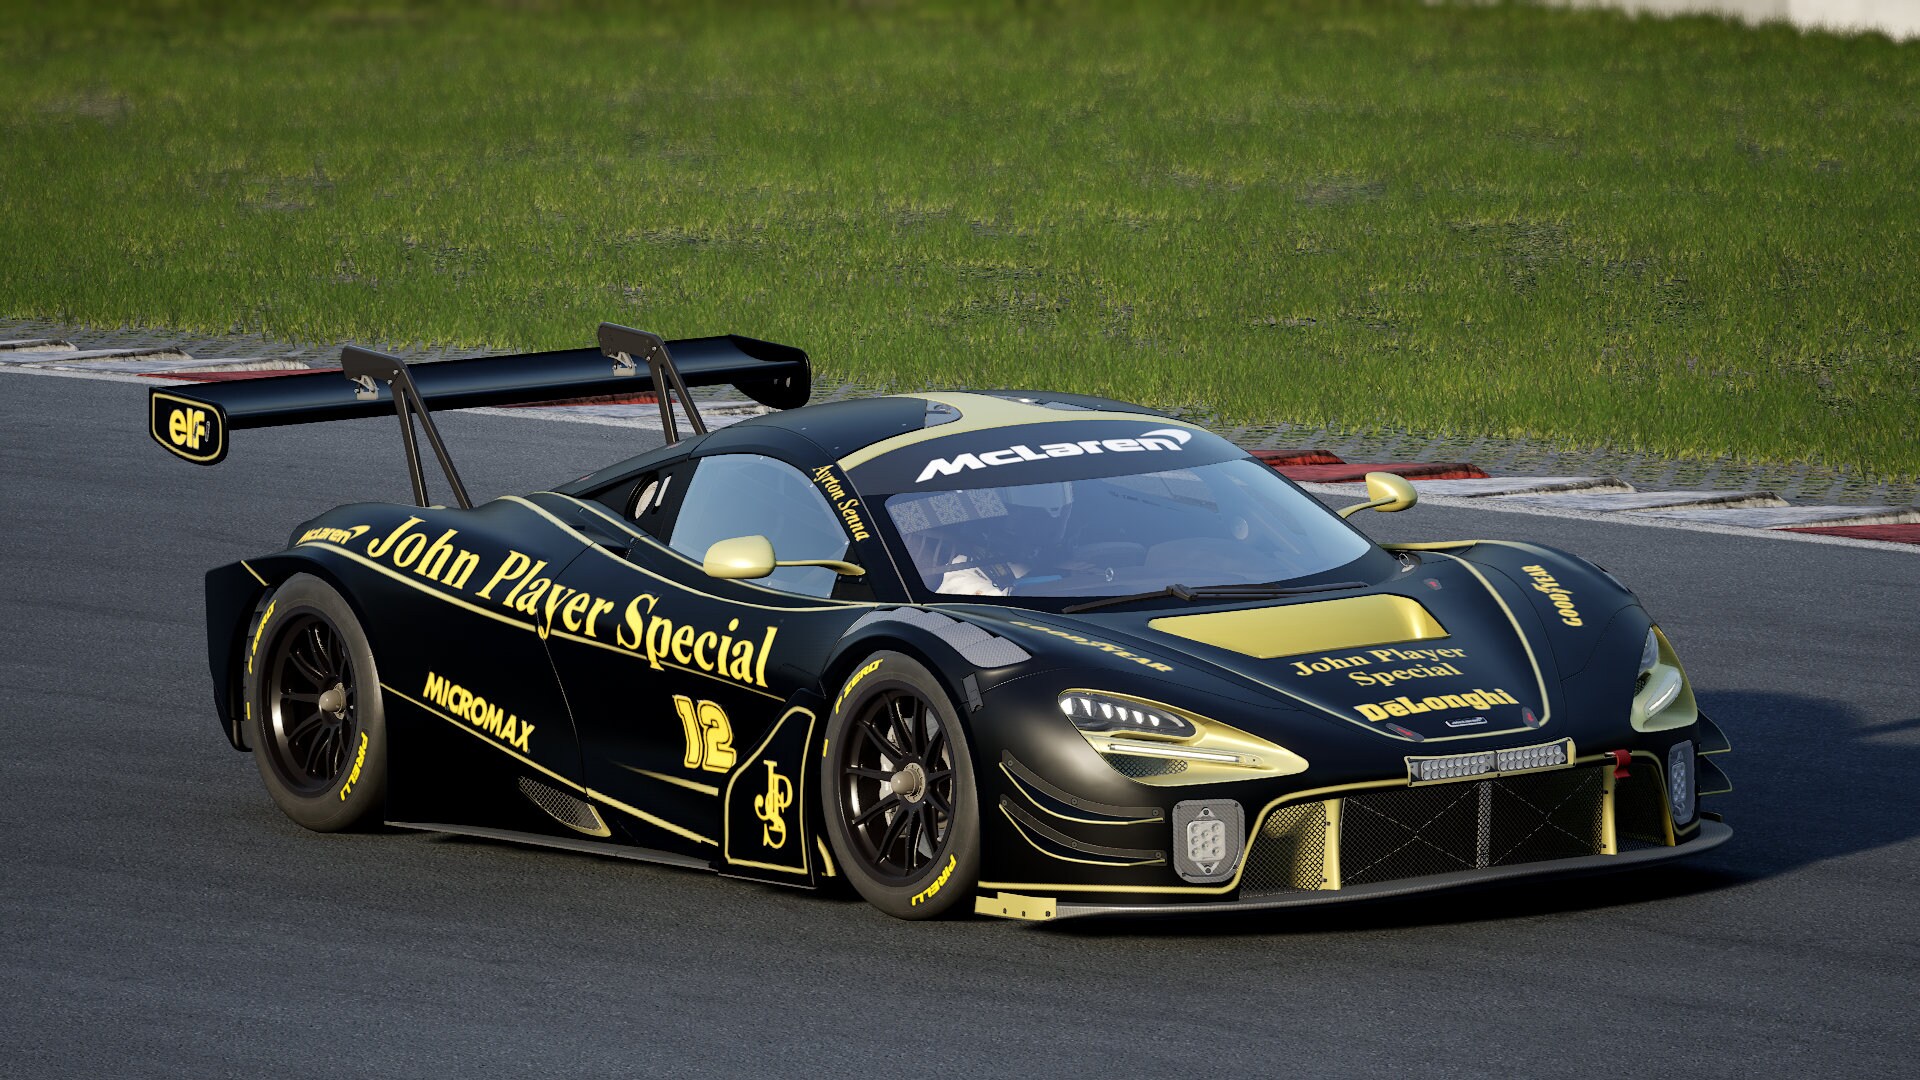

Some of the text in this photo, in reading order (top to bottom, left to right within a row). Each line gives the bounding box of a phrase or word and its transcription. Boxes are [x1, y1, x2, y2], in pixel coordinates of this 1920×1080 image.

[169, 408, 206, 449] elf
[914, 434, 1185, 483] McLaren
[812, 464, 870, 542] Ayrton Senna
[367, 515, 778, 688] John Player Special
[1289, 646, 1468, 677] John Player
[1349, 661, 1465, 687] Special
[423, 671, 536, 753] MICROMAX
[672, 694, 737, 774] 12
[911, 854, 957, 906] PIRELLI
